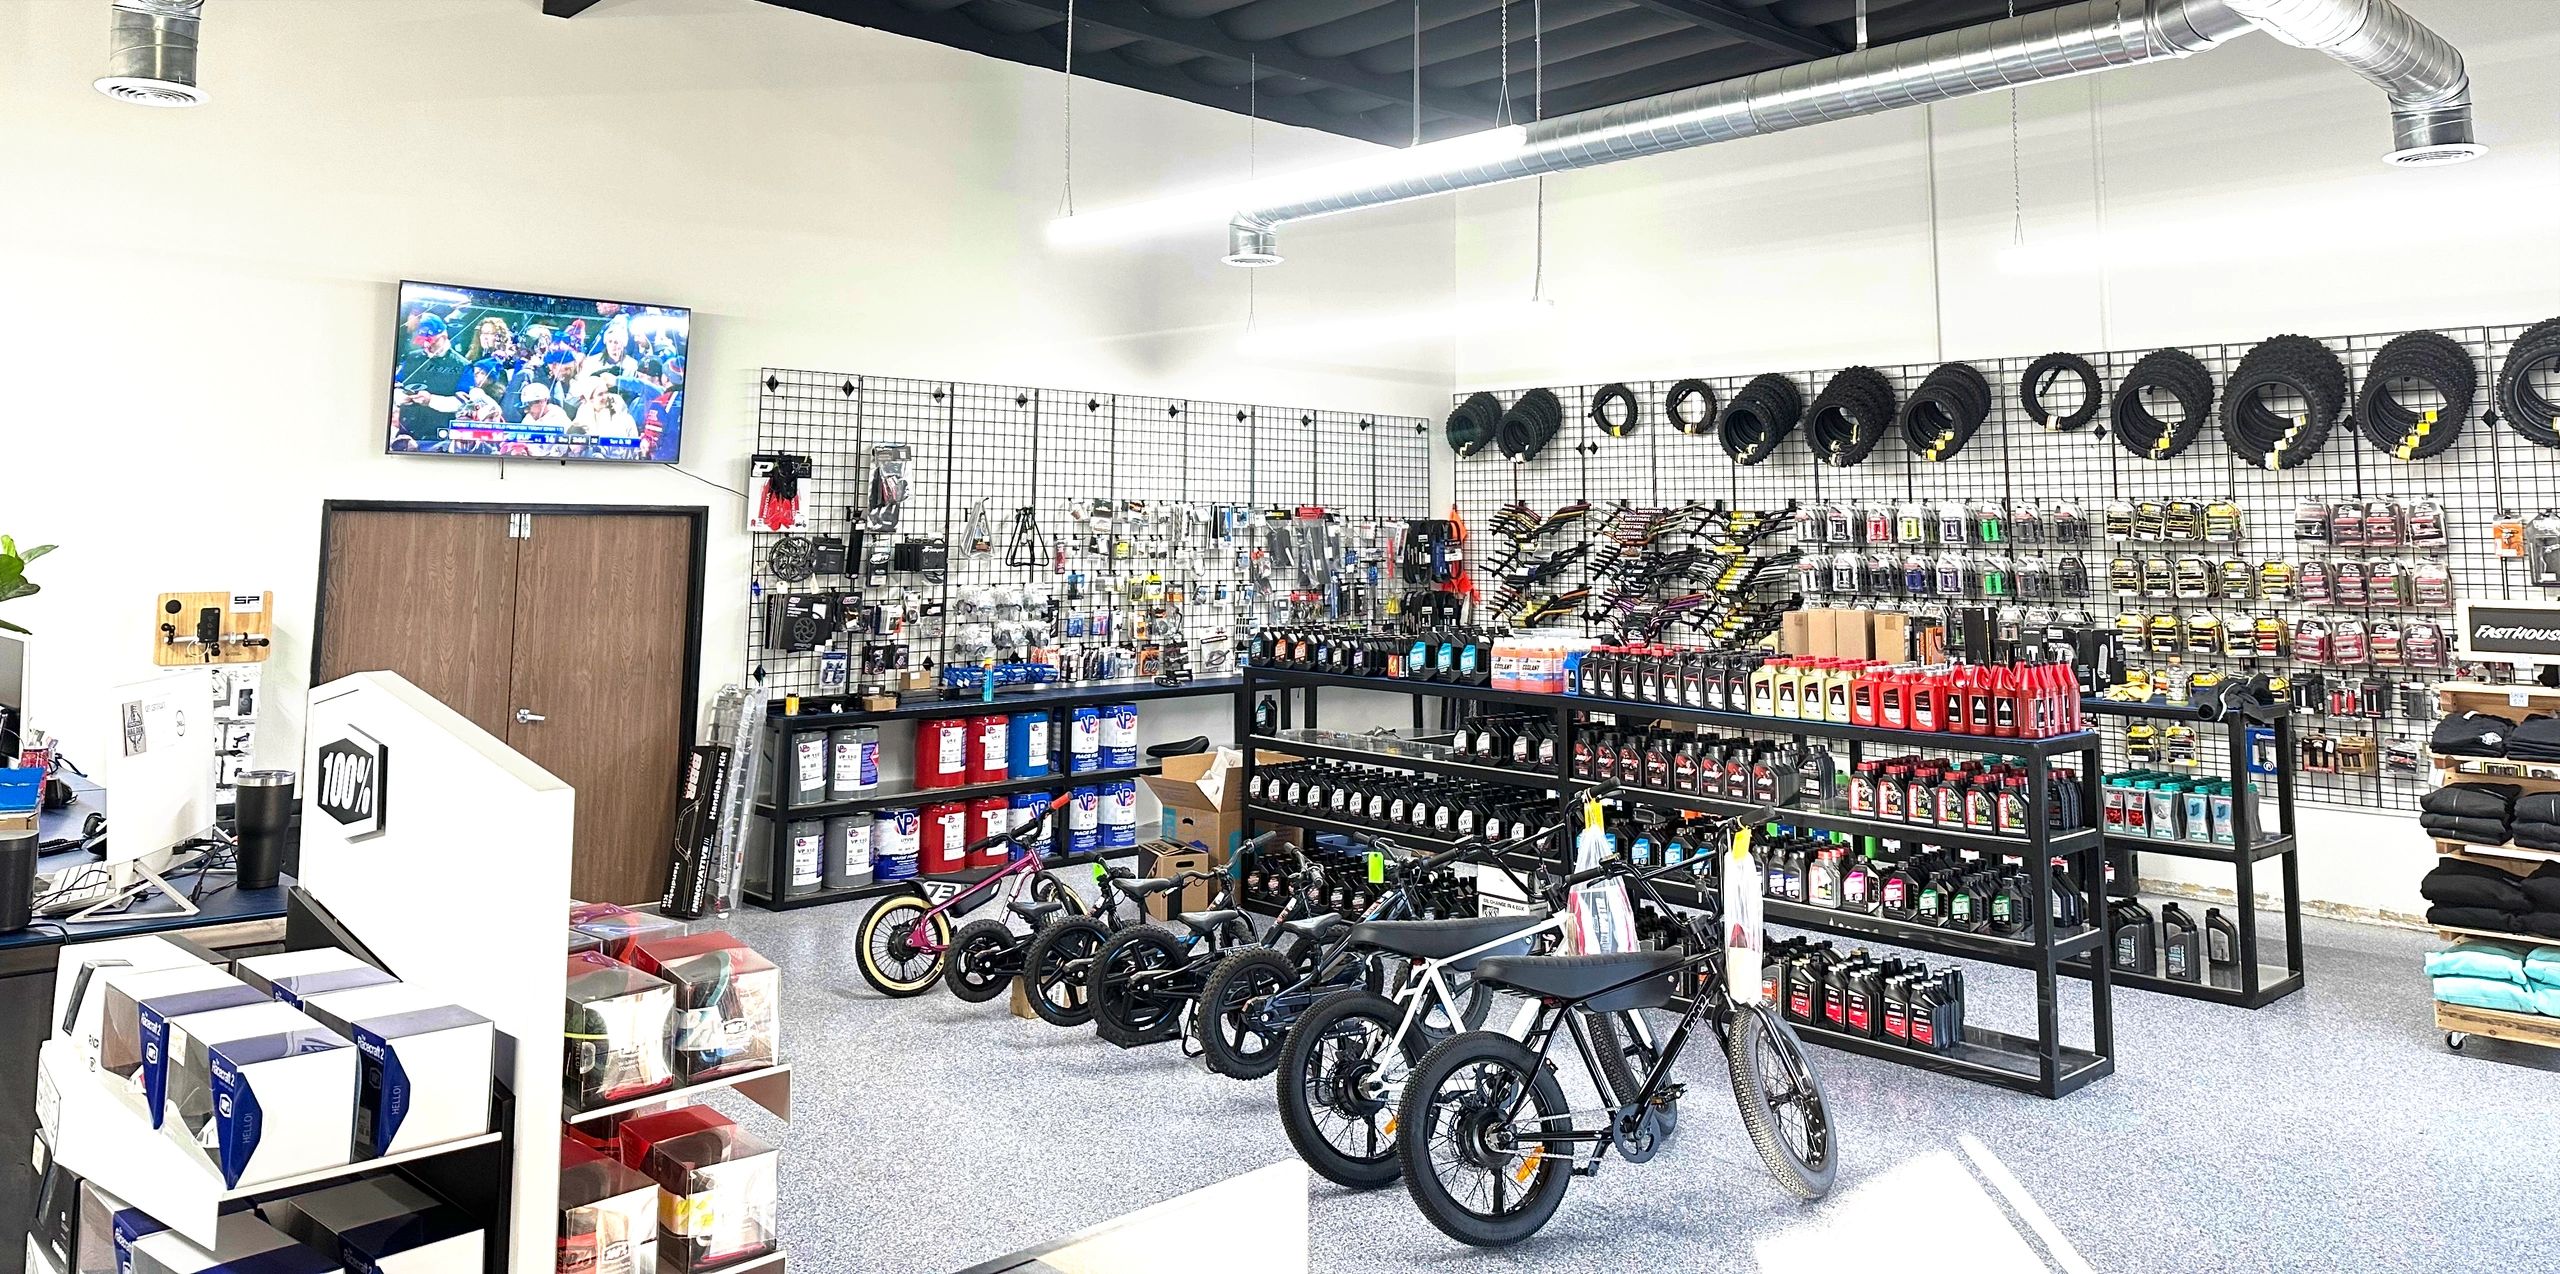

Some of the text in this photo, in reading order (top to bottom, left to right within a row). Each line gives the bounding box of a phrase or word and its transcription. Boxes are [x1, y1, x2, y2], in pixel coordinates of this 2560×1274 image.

[2474, 624, 2560, 641] FASTHOUS
[1081, 715, 1097, 734] VP
[1117, 712, 1133, 730] VP
[321, 752, 373, 815] 100%
[686, 752, 703, 800] BBR
[708, 751, 728, 820] Handlebar Kit
[1079, 792, 1095, 811] VP
[1116, 789, 1131, 807] VP
[894, 812, 915, 836] VP
[668, 862, 680, 908] Handlebar
[691, 845, 709, 913] INNOVATIVE
[927, 883, 956, 898] 73
[661, 894, 669, 908] Kit
[140, 1013, 157, 1034] Racecraft
[357, 1036, 380, 1059] Racecraft
[211, 1060, 230, 1084] Racecraft
[391, 1085, 401, 1115] HELLO!
[242, 1112, 253, 1144] HELLO!
